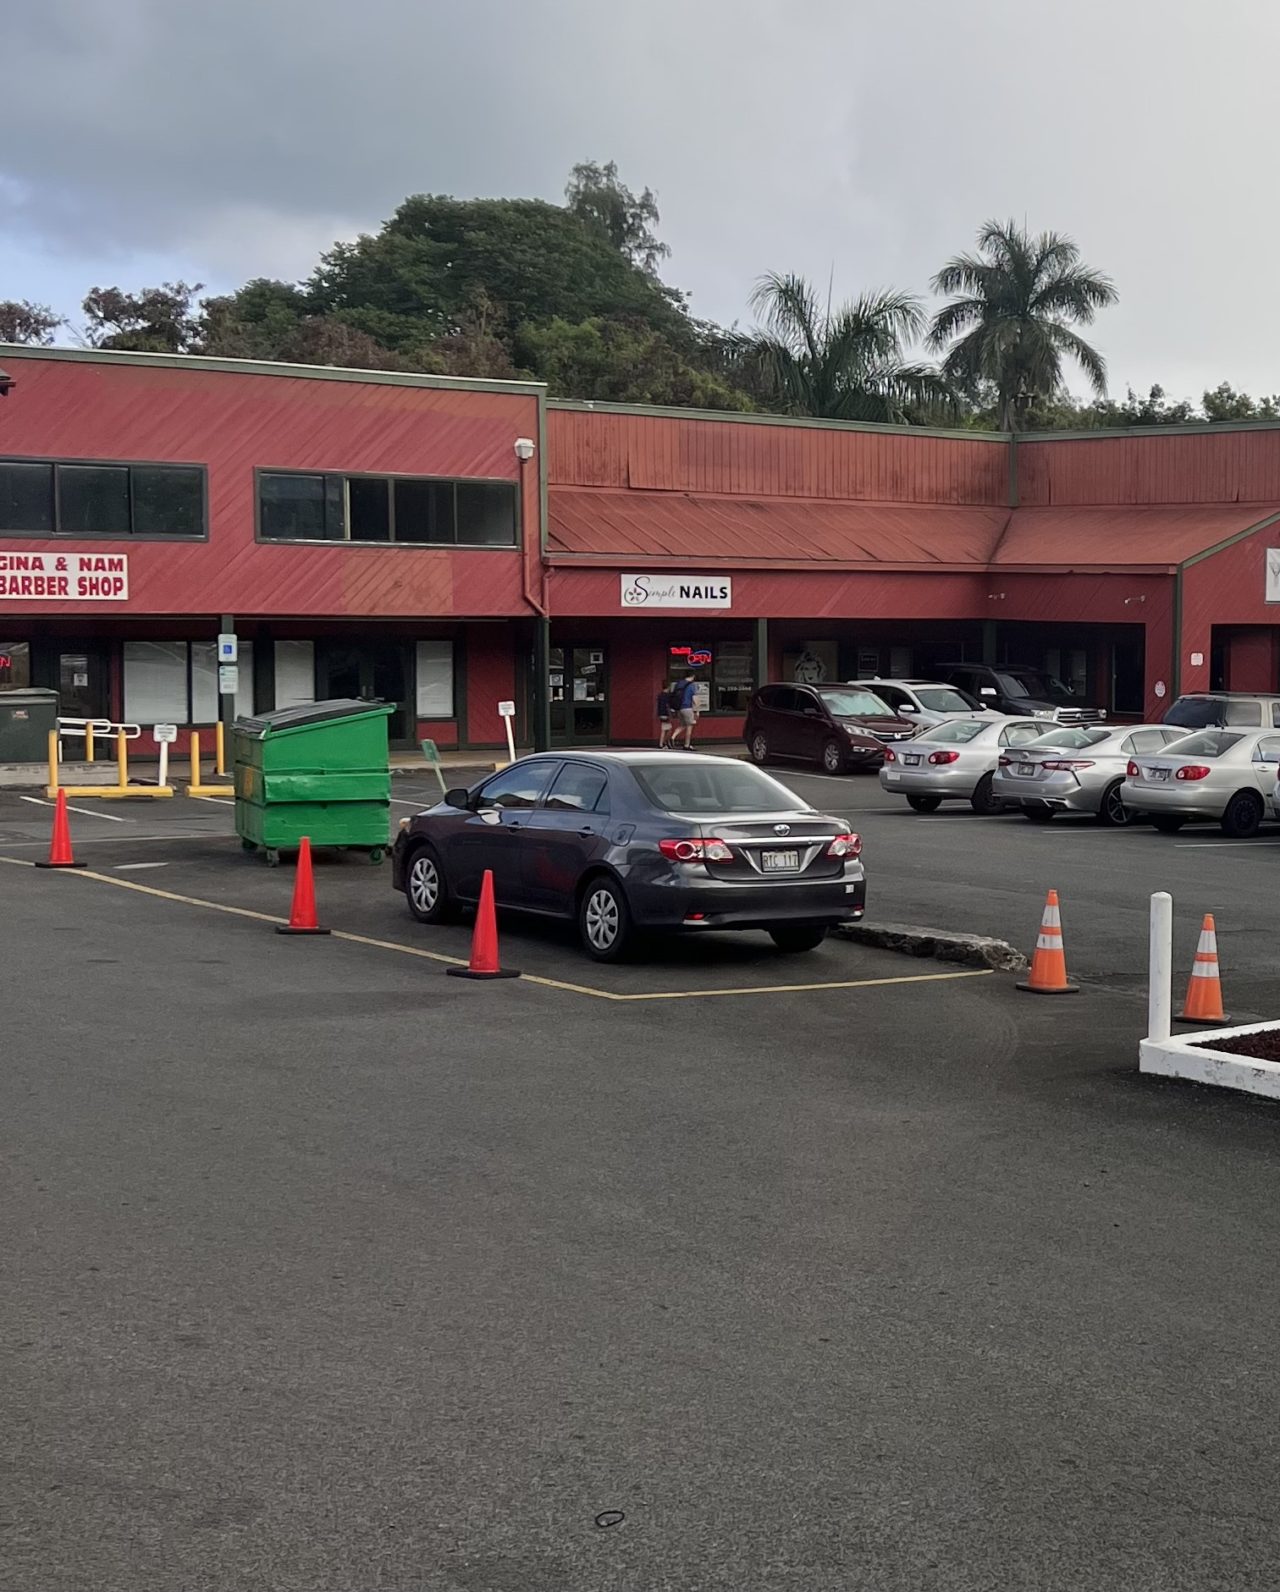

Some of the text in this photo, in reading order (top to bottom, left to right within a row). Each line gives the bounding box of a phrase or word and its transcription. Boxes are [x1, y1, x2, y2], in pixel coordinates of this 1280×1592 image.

[55, 557, 68, 571] &
[79, 558, 124, 572] NAM
[0, 576, 123, 596] BARBER SHOP
[680, 586, 728, 599] NAILS
